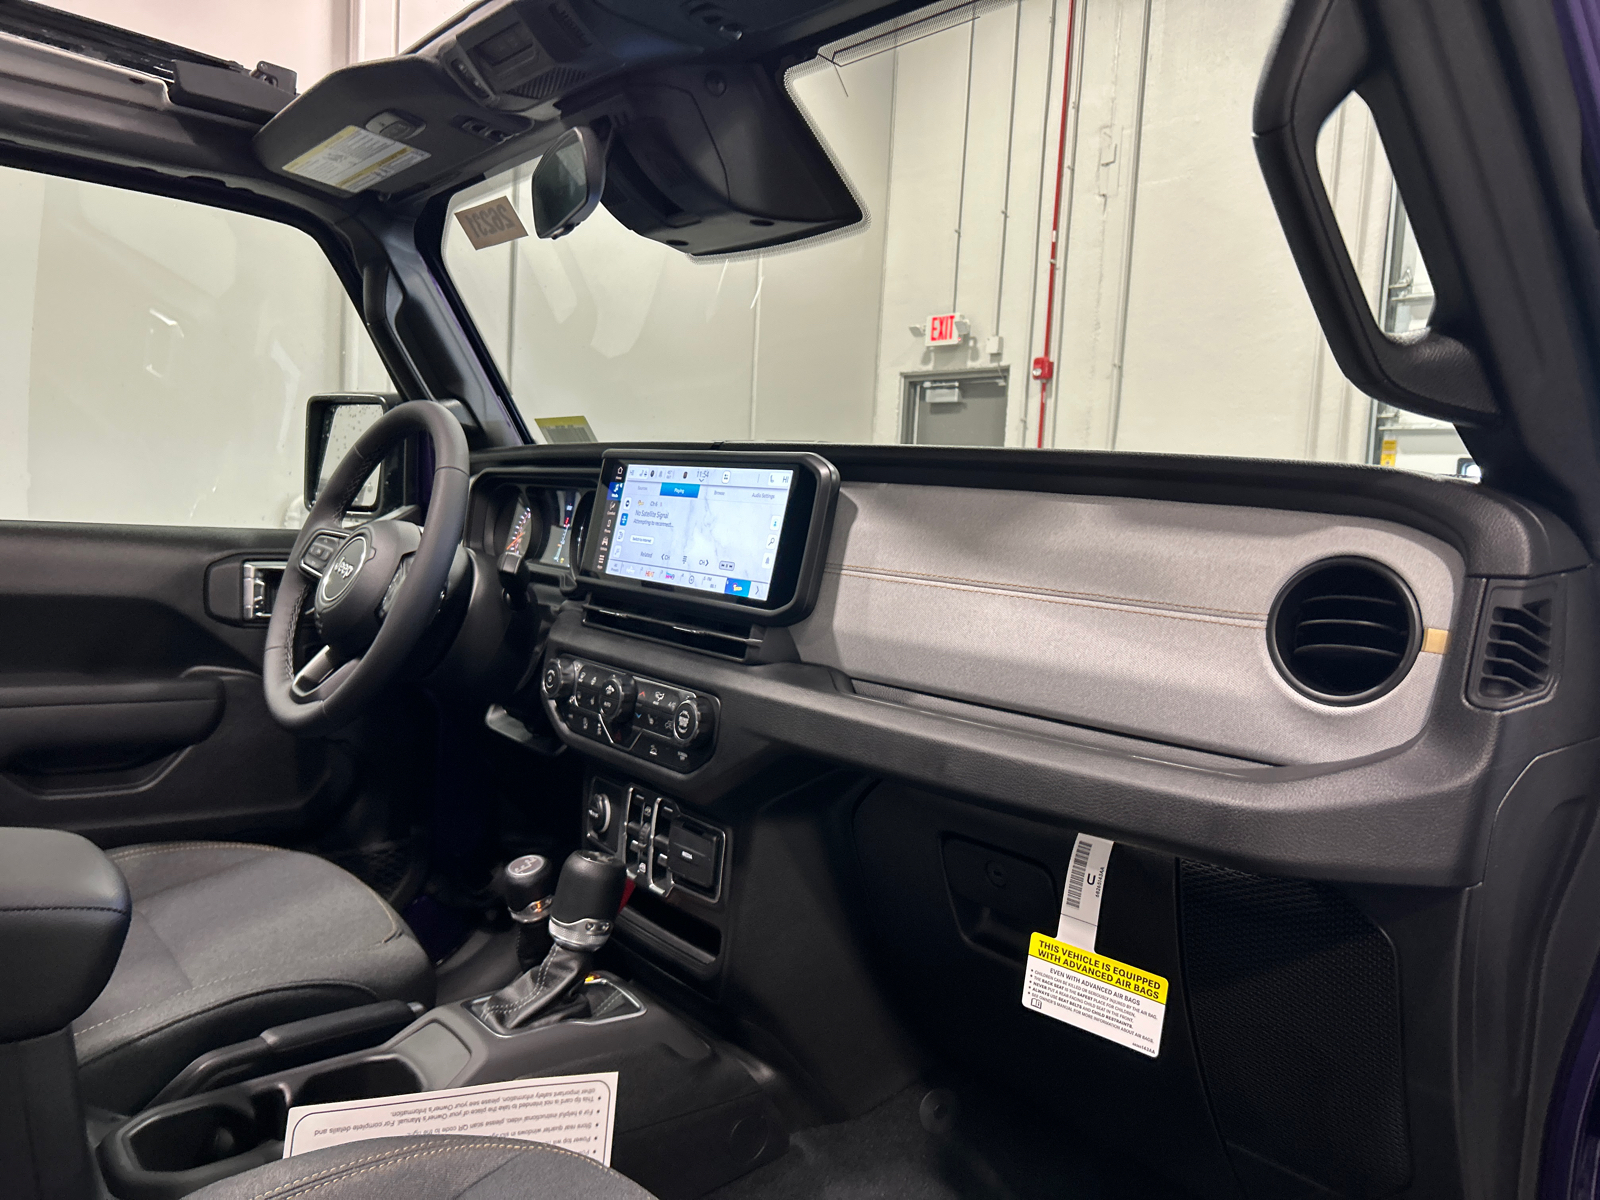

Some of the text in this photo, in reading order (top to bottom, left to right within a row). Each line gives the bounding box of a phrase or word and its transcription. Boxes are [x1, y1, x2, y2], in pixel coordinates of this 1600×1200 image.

[930, 315, 955, 341] EXIT
[334, 557, 354, 579] Jeep
[1087, 873, 1096, 885] U
[1038, 939, 1160, 990] THIS VEHICLE IS EQUIPPED
[1037, 948, 1158, 999] WITH ADVANCED AIR BAGS
[1049, 967, 1140, 1006] EVEN WITH ADVANCED AIR BAGS
[535, 1090, 552, 1099] safety
[553, 1088, 580, 1097] important
[454, 1100, 468, 1108] your
[480, 1096, 500, 1106] please
[518, 1100, 542, 1109] intended
[428, 1104, 453, 1112] Owner's
[471, 1107, 486, 1115] place
[422, 1113, 447, 1122] Owner's
[524, 1112, 557, 1122] instructional
[558, 1109, 577, 1118] helpful
[352, 1121, 382, 1131] complete
[485, 1118, 504, 1126] please
[329, 1125, 351, 1134] details
[517, 1128, 541, 1136] windows
[542, 1124, 562, 1133] quarter
